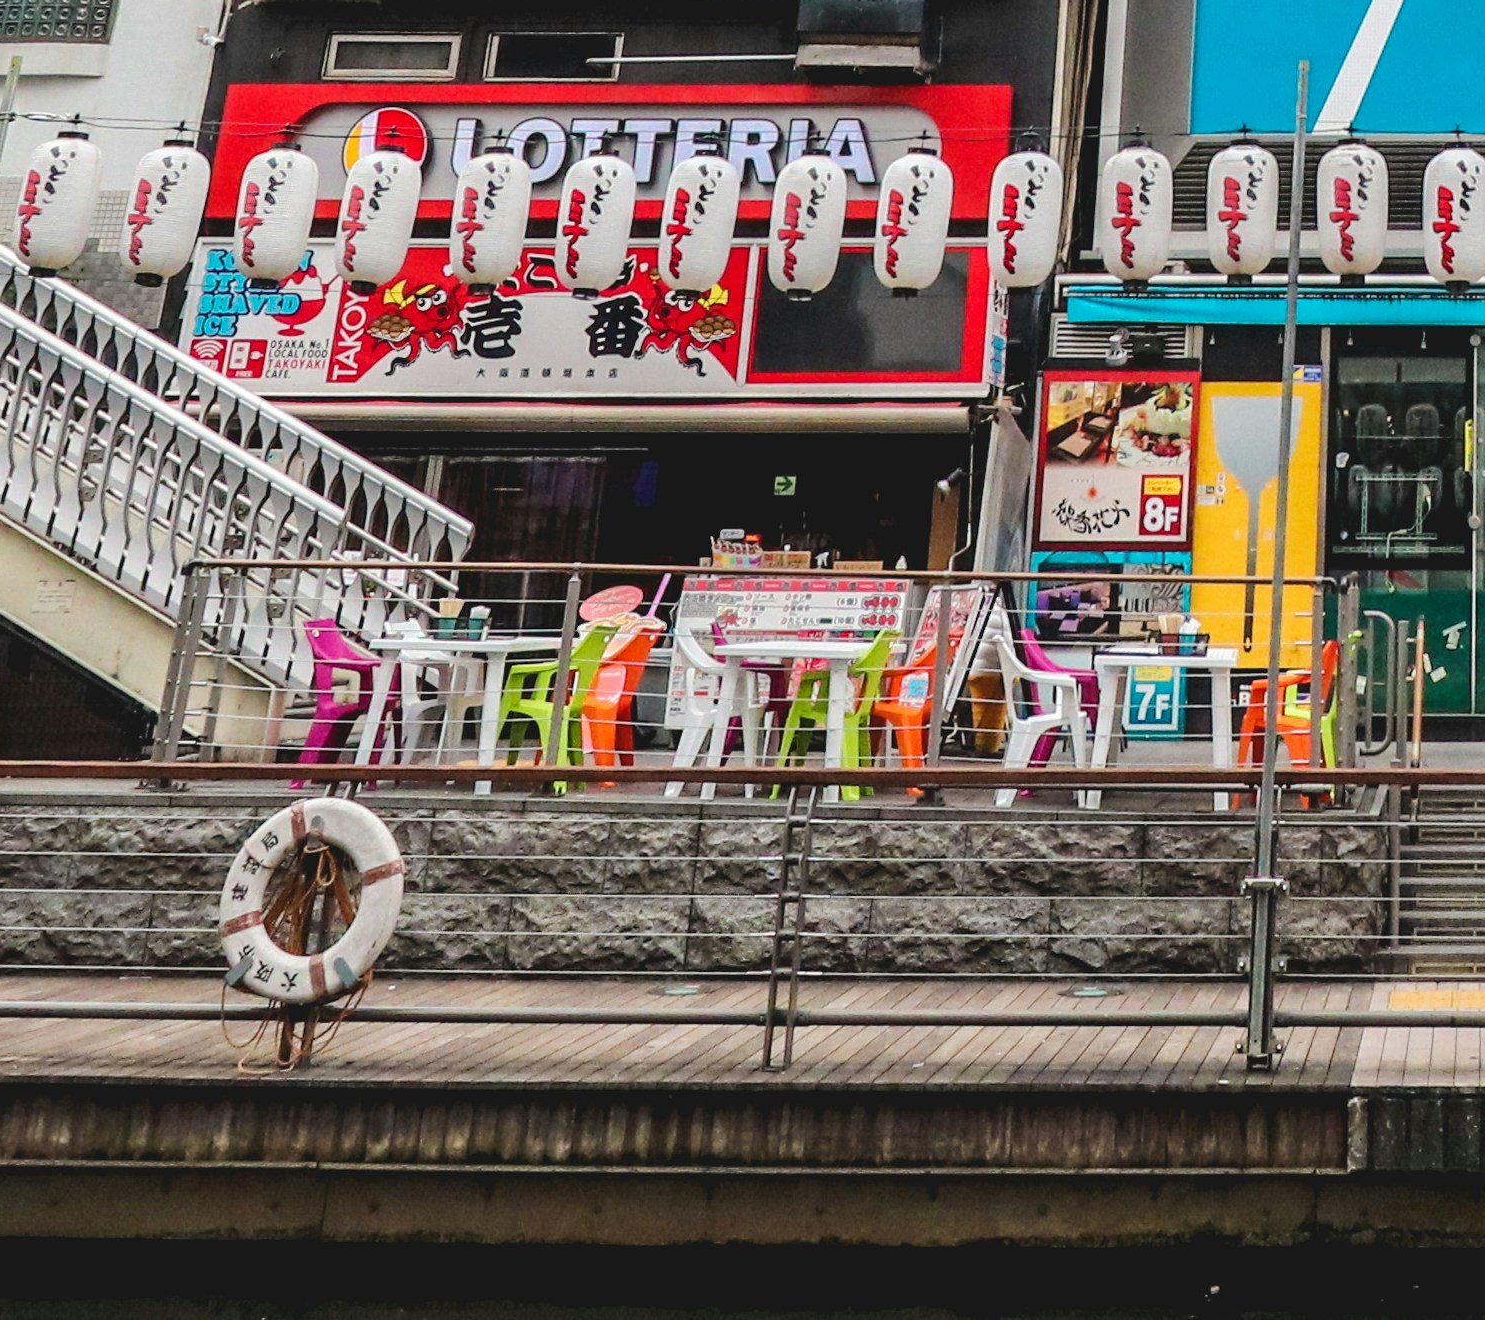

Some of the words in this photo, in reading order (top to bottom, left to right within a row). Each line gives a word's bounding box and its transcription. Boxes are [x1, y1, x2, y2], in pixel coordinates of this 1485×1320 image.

[448, 116, 879, 186] LOTTERIA
[197, 293, 302, 316] SHAVED
[193, 315, 238, 337] ICE
[268, 349, 300, 358] LOCAL
[301, 349, 328, 358] FOOD
[270, 340, 304, 349] OSAKA
[267, 359, 326, 369] TAKOYAKI
[1142, 496, 1179, 534] 8F
[1134, 683, 1171, 721] 7F
